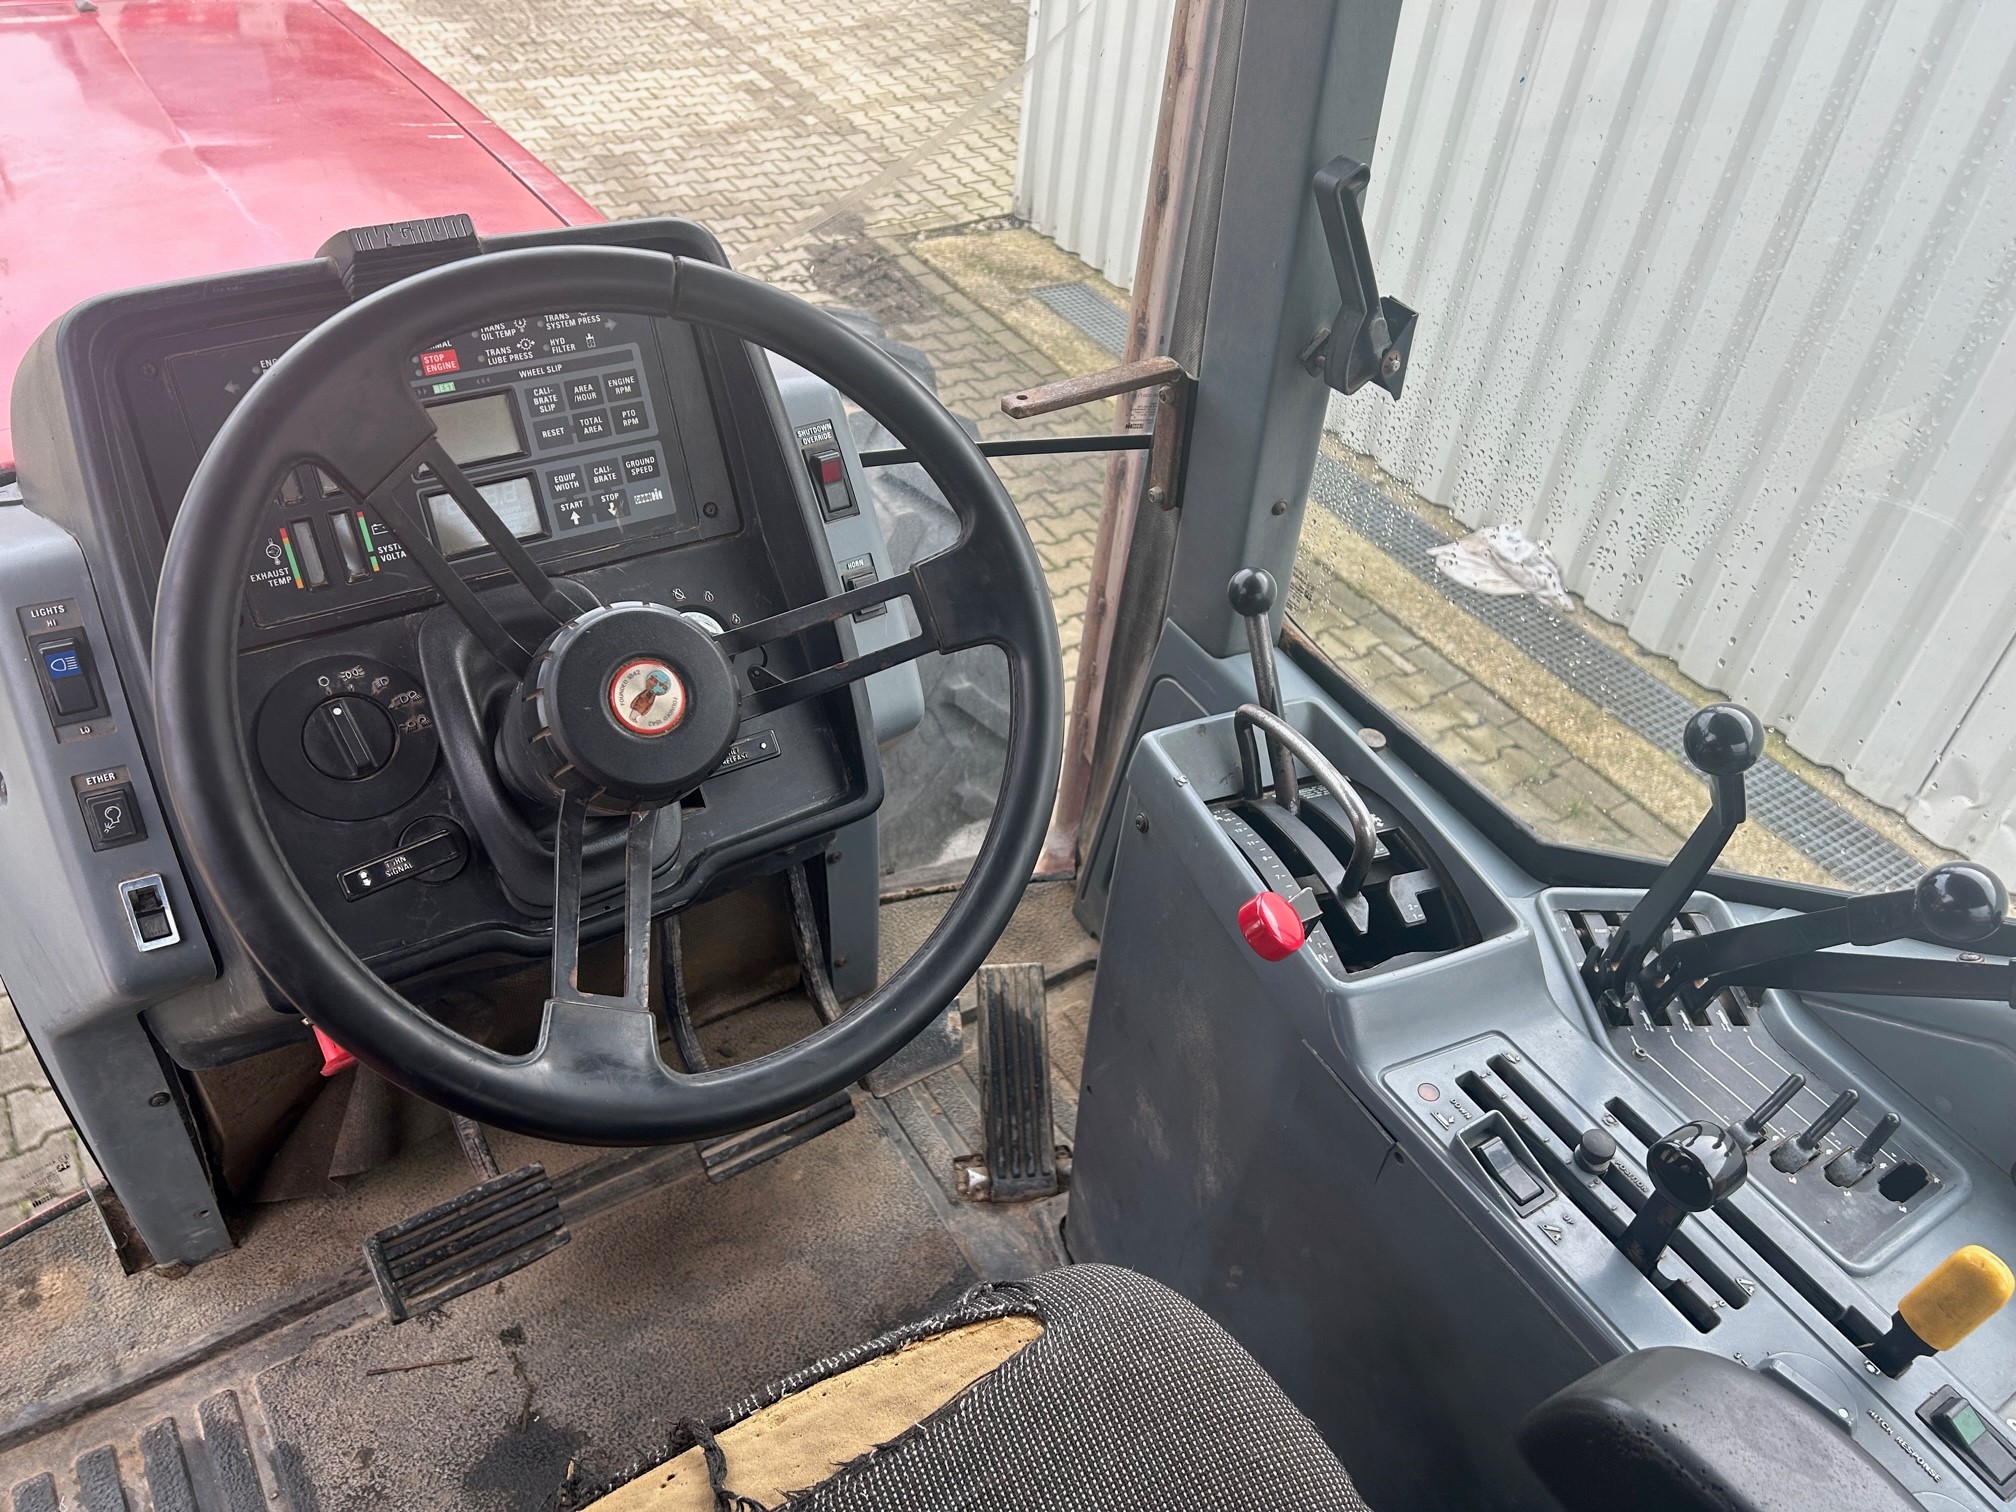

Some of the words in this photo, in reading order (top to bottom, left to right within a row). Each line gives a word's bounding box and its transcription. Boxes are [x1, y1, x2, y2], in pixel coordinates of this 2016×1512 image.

[351, 214, 474, 251] MAGNUM
[544, 313, 570, 322] TRANS
[546, 320, 577, 330] SYSTEM
[578, 315, 601, 325] PRESS
[481, 333, 494, 341] OIL
[495, 328, 516, 339] TEMP
[550, 337, 566, 346] HYD
[485, 346, 512, 357] TRANS
[551, 344, 576, 354] FILTER
[423, 353, 445, 364] STOP
[487, 355, 508, 365] LUBE
[510, 352, 533, 362] PRESS
[426, 361, 457, 373] ENGINE
[519, 367, 545, 378] WHEEL
[546, 364, 563, 374] SLIP
[607, 375, 635, 387] ENGINE
[434, 382, 455, 393] BEST
[533, 386, 553, 397] CALI-
[574, 383, 593, 394] AREA
[615, 385, 632, 395] RPM
[533, 394, 558, 405] BRATE
[574, 391, 597, 402] /HOUR
[539, 404, 556, 413] SLIP
[621, 409, 636, 418] PTO
[580, 416, 603, 427] TOTAL
[623, 417, 639, 427] RPM
[541, 427, 565, 438] RESET
[583, 424, 603, 435] AREA
[797, 423, 832, 438] SHUTDOWN
[802, 432, 832, 445] OVERRIDE
[625, 456, 655, 468] GROUND
[593, 465, 613, 475] CALI-
[631, 465, 654, 476] SPEED
[554, 472, 576, 484] EQUIP
[593, 473, 617, 484] BRATE
[554, 480, 580, 492] WIDTH
[601, 492, 619, 503] STOP
[560, 500, 583, 512] START
[847, 559, 864, 570] HORN
[250, 567, 289, 583] EXHAUST
[268, 576, 292, 588] TEMP
[30, 604, 65, 618] LIGHTS
[46, 619, 57, 627] HI
[628, 670, 640, 680] 1842
[80, 726, 91, 734] LO
[86, 772, 116, 786] ETHER
[385, 863, 413, 878] SIGNAL
[1450, 1098, 1472, 1120] DOWN
[1615, 1161, 1648, 1193] POSITION
[1562, 1214, 1575, 1225] UP
[1866, 1409, 1893, 1436] HITCH
[1894, 1436, 1942, 1483] RESPONSE
